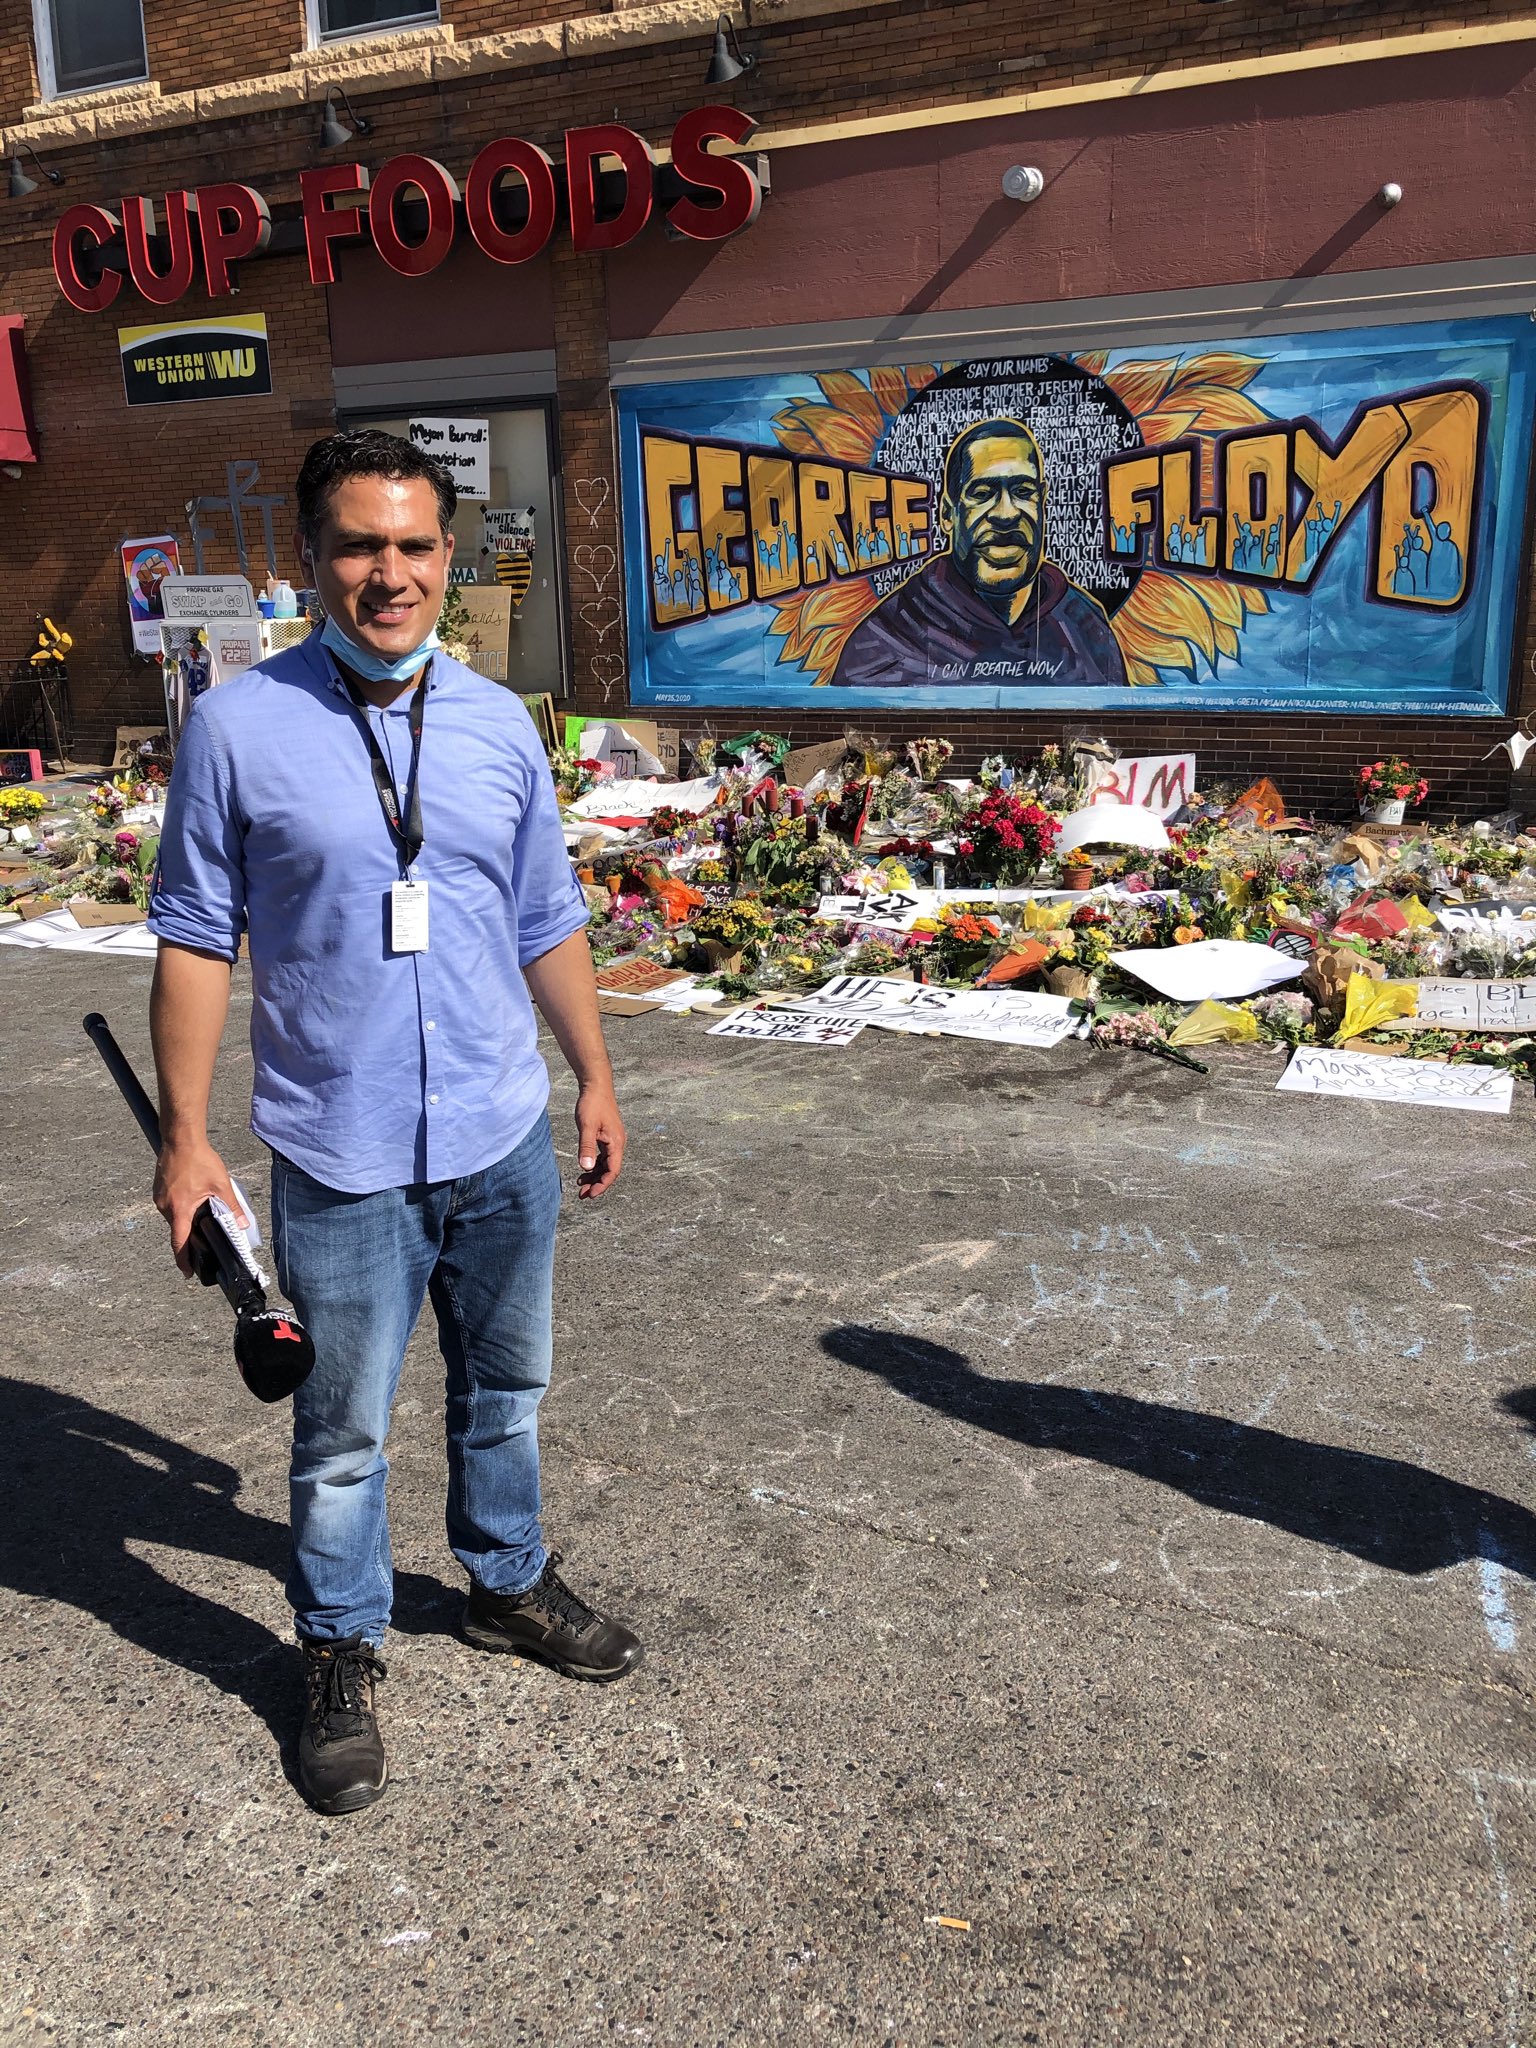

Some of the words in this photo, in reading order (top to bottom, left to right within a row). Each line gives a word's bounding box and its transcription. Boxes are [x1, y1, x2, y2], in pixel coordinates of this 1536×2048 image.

[53, 182, 271, 313] CUP
[299, 104, 762, 284] FOODS
[134, 352, 203, 373] WESTERN
[211, 347, 257, 379] WU
[966, 361, 990, 379] SAY
[991, 359, 1015, 377] OUR
[1016, 357, 1050, 375] NAMES
[157, 366, 206, 385] UNION
[927, 386, 981, 403] TERRENCE
[983, 381, 1034, 400] CRUTCHER
[1037, 379, 1084, 396] JEREMY
[983, 395, 1040, 410] PHILANDO
[1050, 391, 1093, 406] CASTILE
[896, 413, 917, 427] AKAI
[990, 405, 1024, 420] JAMES
[1030, 405, 1075, 419] FREDDIE
[1076, 402, 1106, 416] GREY
[891, 422, 935, 438] MICHAEL
[1024, 416, 1068, 429] TERRANCE
[1069, 415, 1116, 427] FRANKLIN
[884, 437, 919, 451] TYISHA
[1034, 426, 1080, 441] BREONNA
[1080, 424, 1120, 439] TAYLOR
[877, 449, 899, 463] ERIC
[900, 447, 944, 461] GARNER
[1039, 438, 1085, 453] SHANTEL
[1086, 437, 1118, 451] DAVIS
[884, 460, 925, 473] SANDRA
[1044, 451, 1085, 466] WALTER
[1043, 463, 1074, 478] REKIA
[641, 433, 931, 626] GEORGE
[1104, 385, 1484, 610] FLOYD
[1046, 490, 1085, 505] SHELLY
[485, 512, 517, 524] WHITE
[1045, 505, 1083, 520] JAMAR
[1045, 519, 1093, 534] TANISHA
[495, 537, 536, 551] VIOLENCE
[1045, 545, 1080, 561] ALTON
[1073, 576, 1130, 589] KATHRYN
[171, 595, 207, 608] SWAP
[225, 595, 243, 608] GO
[209, 609, 239, 617] CYLINDERS
[220, 640, 250, 649] PROPANE
[467, 629, 482, 652] 4
[942, 662, 969, 681] CAN
[970, 660, 1027, 679] BREATHE
[1026, 660, 1064, 678] NOW
[1365, 826, 1412, 837] Bachman's
[696, 885, 731, 895] BLACK
[829, 976, 905, 1001] HE
[735, 1010, 869, 1029] PROSECUTE
[768, 1022, 811, 1032] THE
[719, 1024, 811, 1039] POLICE
